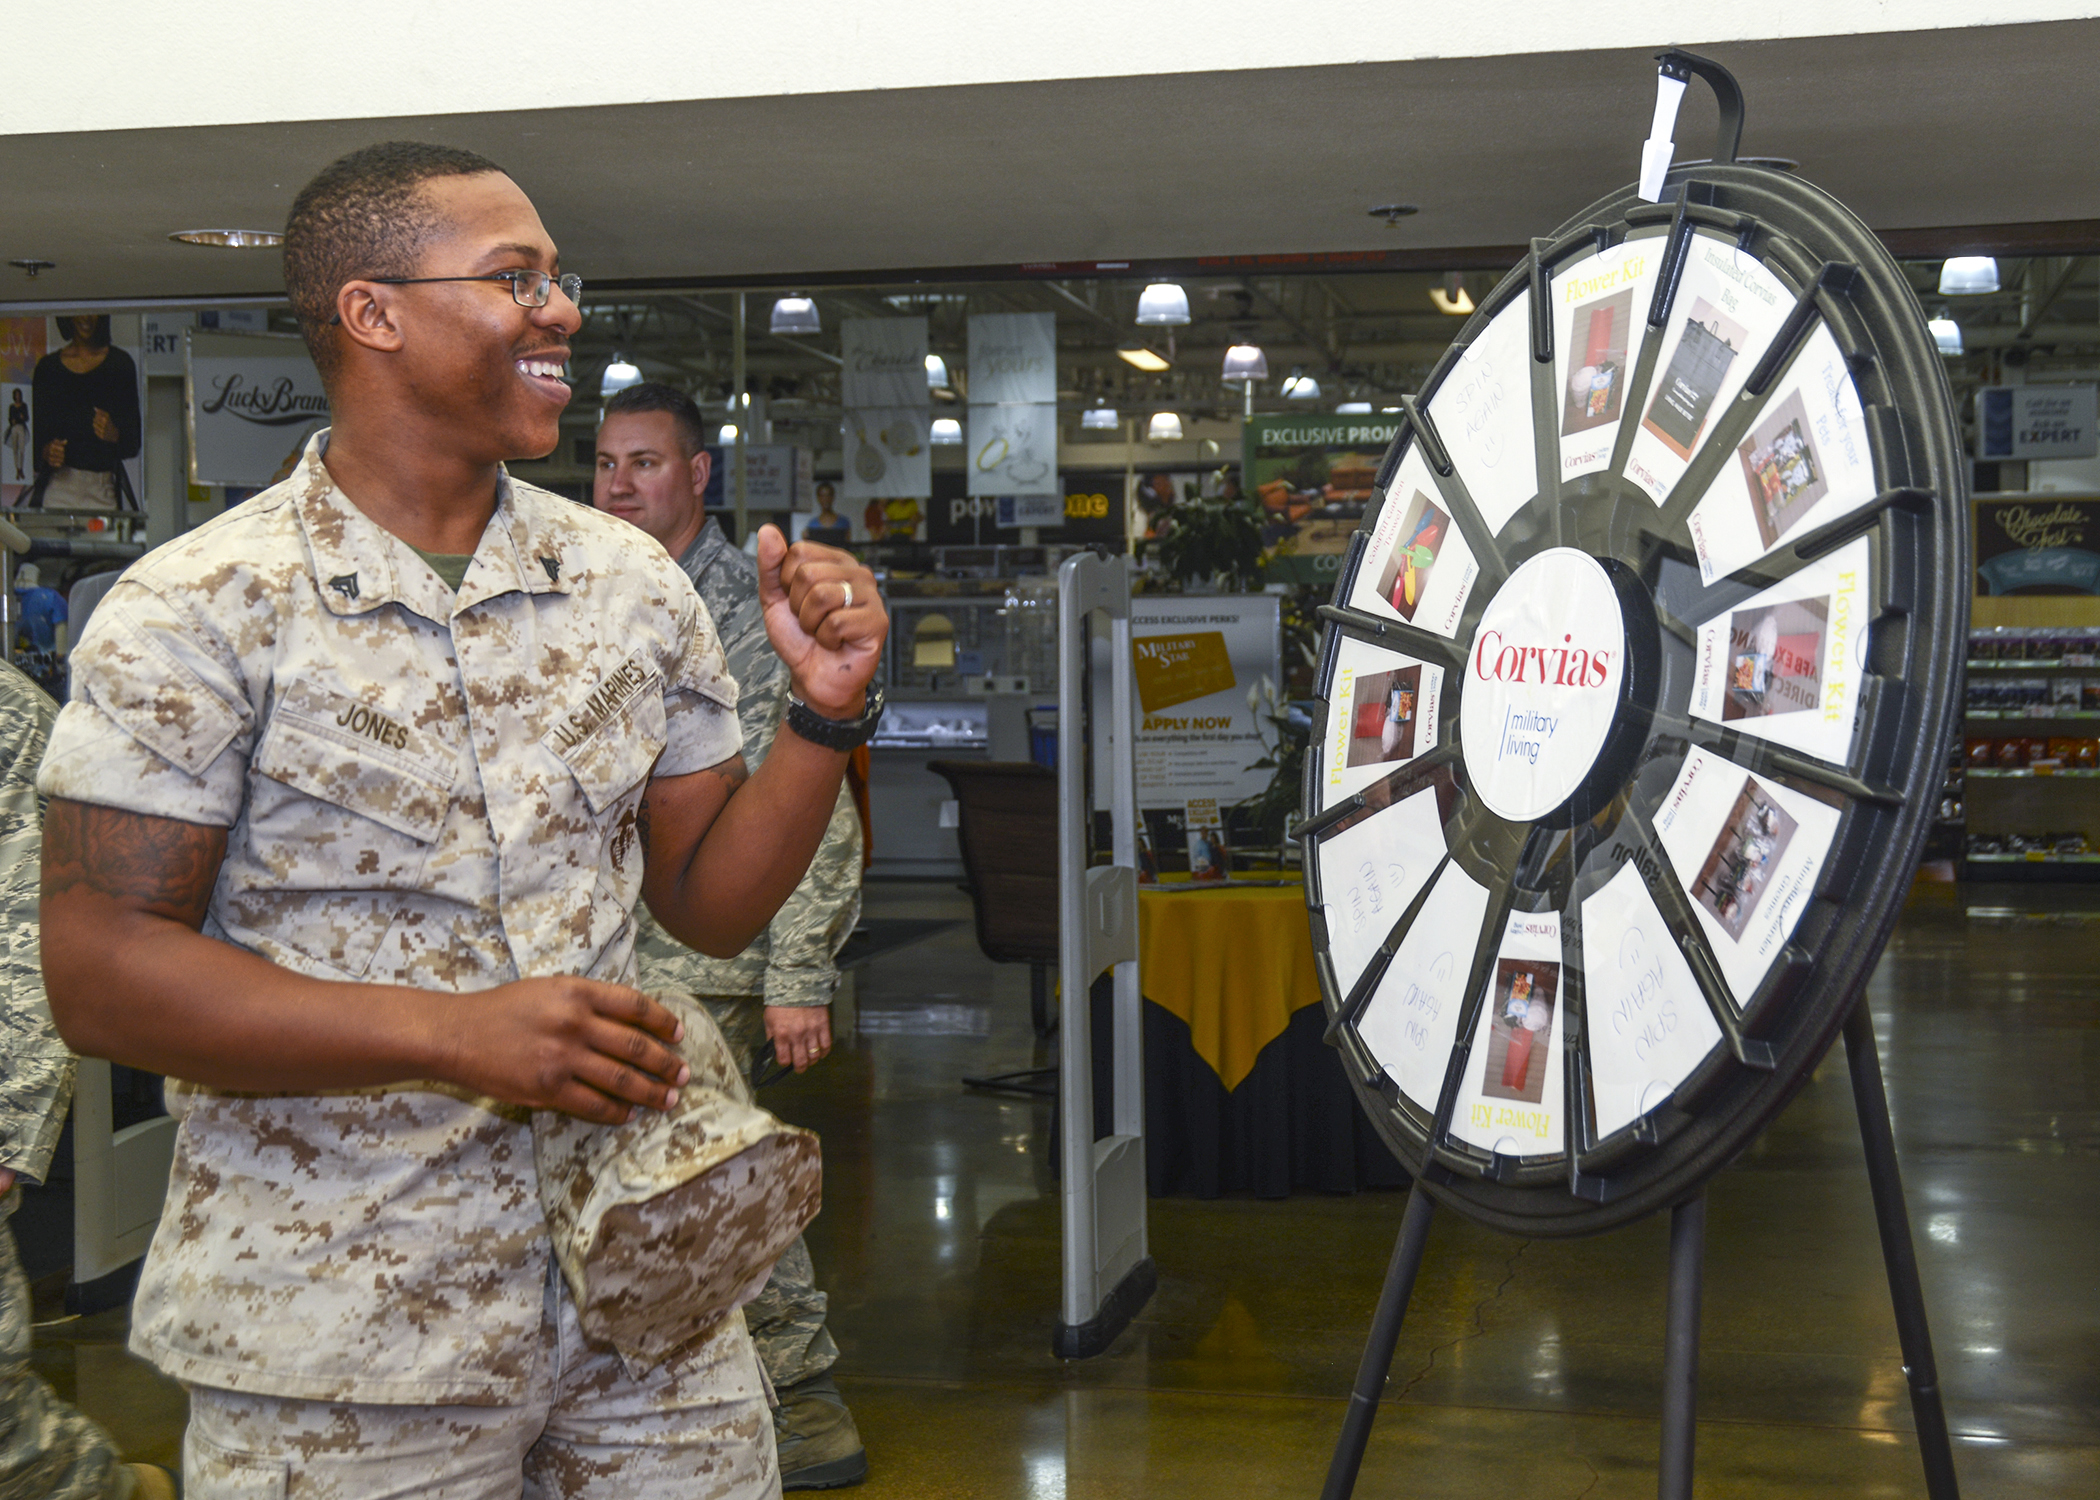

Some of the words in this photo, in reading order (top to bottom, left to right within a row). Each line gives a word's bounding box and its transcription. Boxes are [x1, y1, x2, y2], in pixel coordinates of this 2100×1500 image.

[1565, 268, 1618, 303] Flower
[1622, 255, 1645, 281] Kit
[1704, 247, 1742, 284] Insulated
[1742, 271, 1778, 307] Corvias
[1720, 287, 1739, 313] Bag
[202, 373, 270, 414] Lucky
[1456, 362, 1494, 414] SPIN
[1466, 382, 1504, 442] AGAIN
[1816, 414, 1830, 446] Pets
[1821, 361, 1840, 408] Treats
[1839, 431, 1859, 466] your
[1262, 427, 1344, 446] EXCLUSIVE
[2019, 429, 2080, 443] EXPERT
[1564, 445, 1597, 469] Corvias
[1630, 457, 1656, 488] Corvias
[1368, 521, 1389, 565] Colorful
[1387, 480, 1405, 519] Garden
[1384, 511, 1403, 547] Trowel
[1995, 503, 2090, 541] Chocolate
[1161, 614, 1207, 624] EXCLUSIVE
[1444, 583, 1467, 630] Corvias
[1829, 570, 1857, 672] Flower
[1475, 630, 1610, 688] Corvias
[1701, 629, 1717, 686] Corvias
[553, 715, 593, 748] U.S.
[585, 658, 646, 721] MARINES
[1339, 667, 1353, 699] Kit
[1823, 681, 1846, 723] Kit
[336, 704, 409, 750] JONES
[1142, 717, 1190, 731] APPLY
[1192, 716, 1232, 730] NOW
[1424, 693, 1436, 744] Corvias
[1511, 709, 1558, 739] military
[1331, 704, 1349, 785] Flower
[1506, 734, 1540, 765] living
[1673, 757, 1704, 810] Corvias
[1347, 887, 1367, 934] SPIN
[1525, 922, 1557, 938] Corvias
[1402, 983, 1442, 1022] AGAIN
[1612, 955, 1664, 1036] AGAIN
[1405, 1020, 1429, 1051] SPIN
[1635, 1000, 1678, 1062] SPIN
[1471, 1103, 1493, 1129] Kit
[1494, 1108, 1551, 1138] Flower
